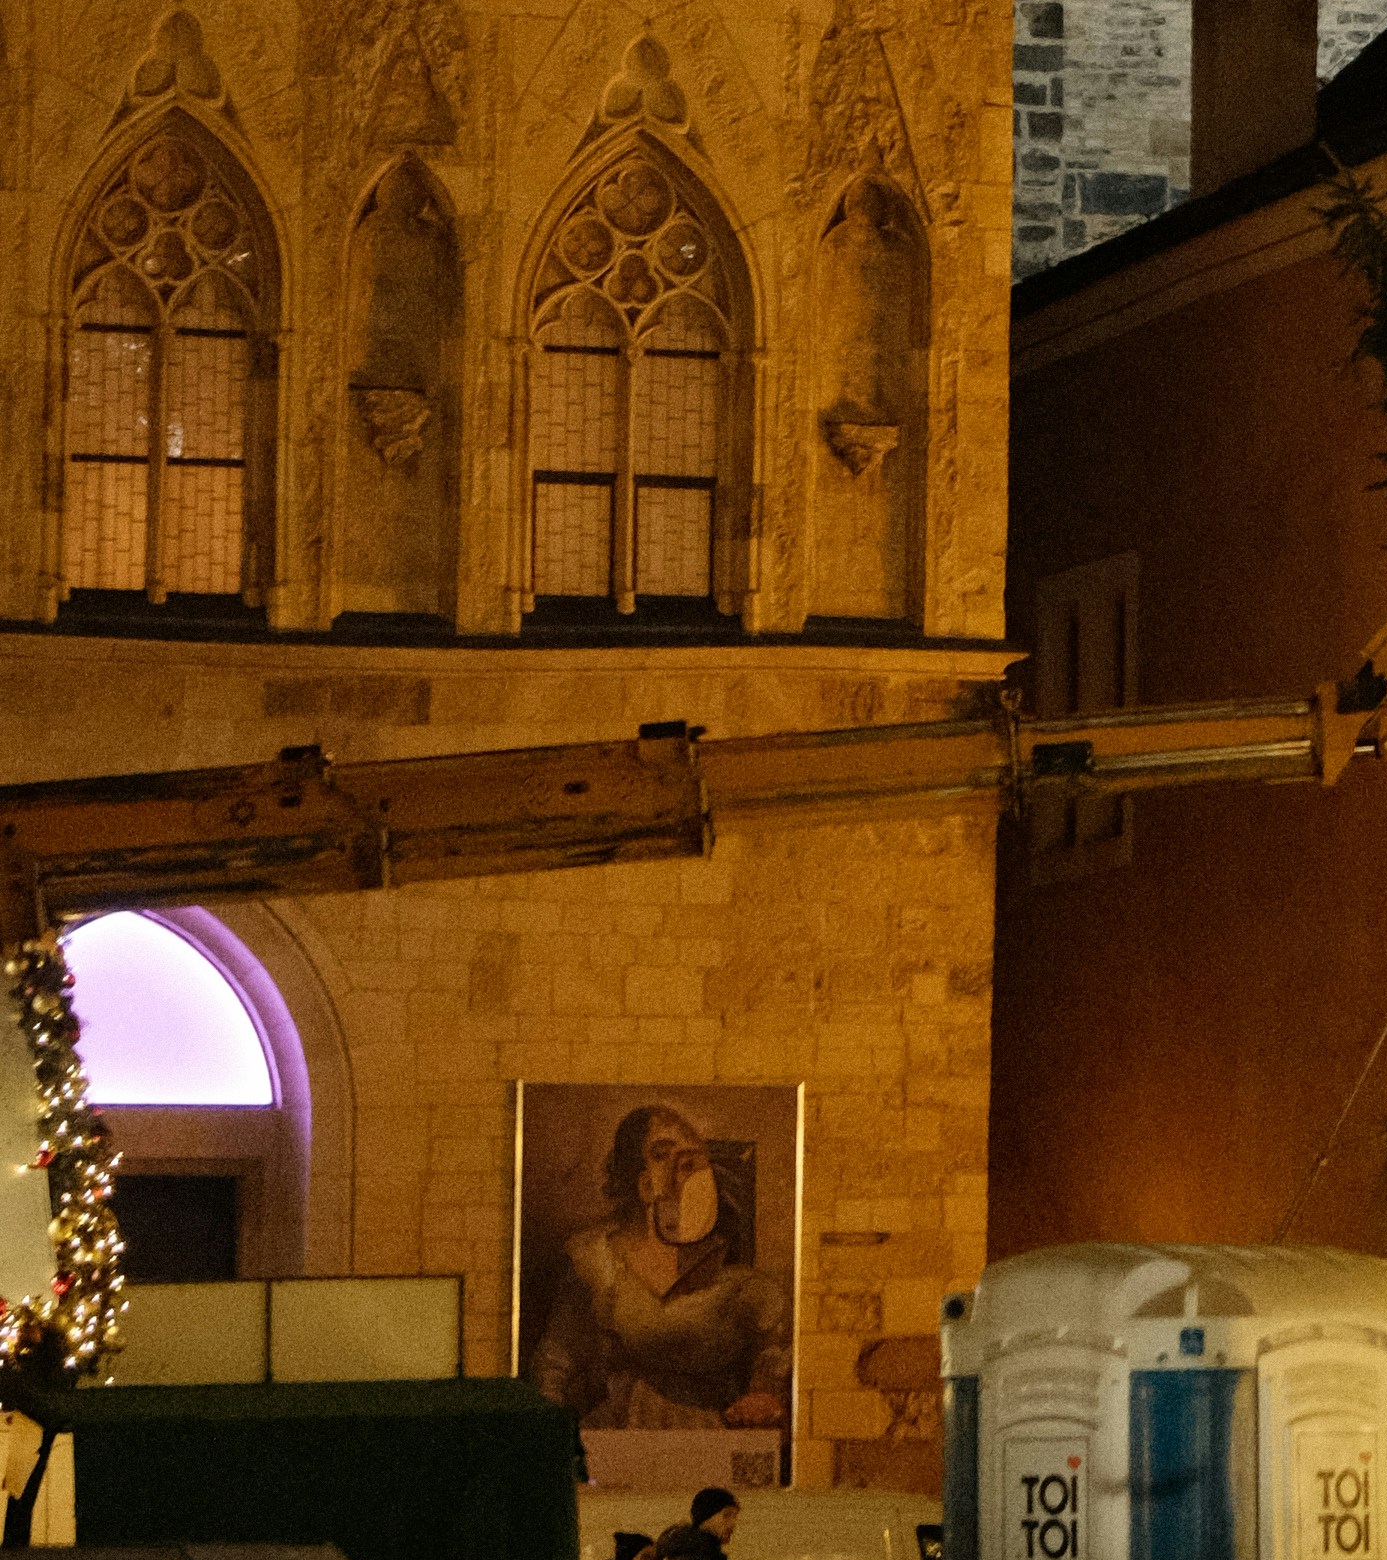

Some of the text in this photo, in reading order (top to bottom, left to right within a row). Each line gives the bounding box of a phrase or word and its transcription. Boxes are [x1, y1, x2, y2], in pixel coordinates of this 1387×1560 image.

[1021, 1473, 1079, 1515] TOI
[1315, 1467, 1370, 1509] TOI
[1020, 1518, 1079, 1560] TOI
[1317, 1512, 1371, 1553] TOI
